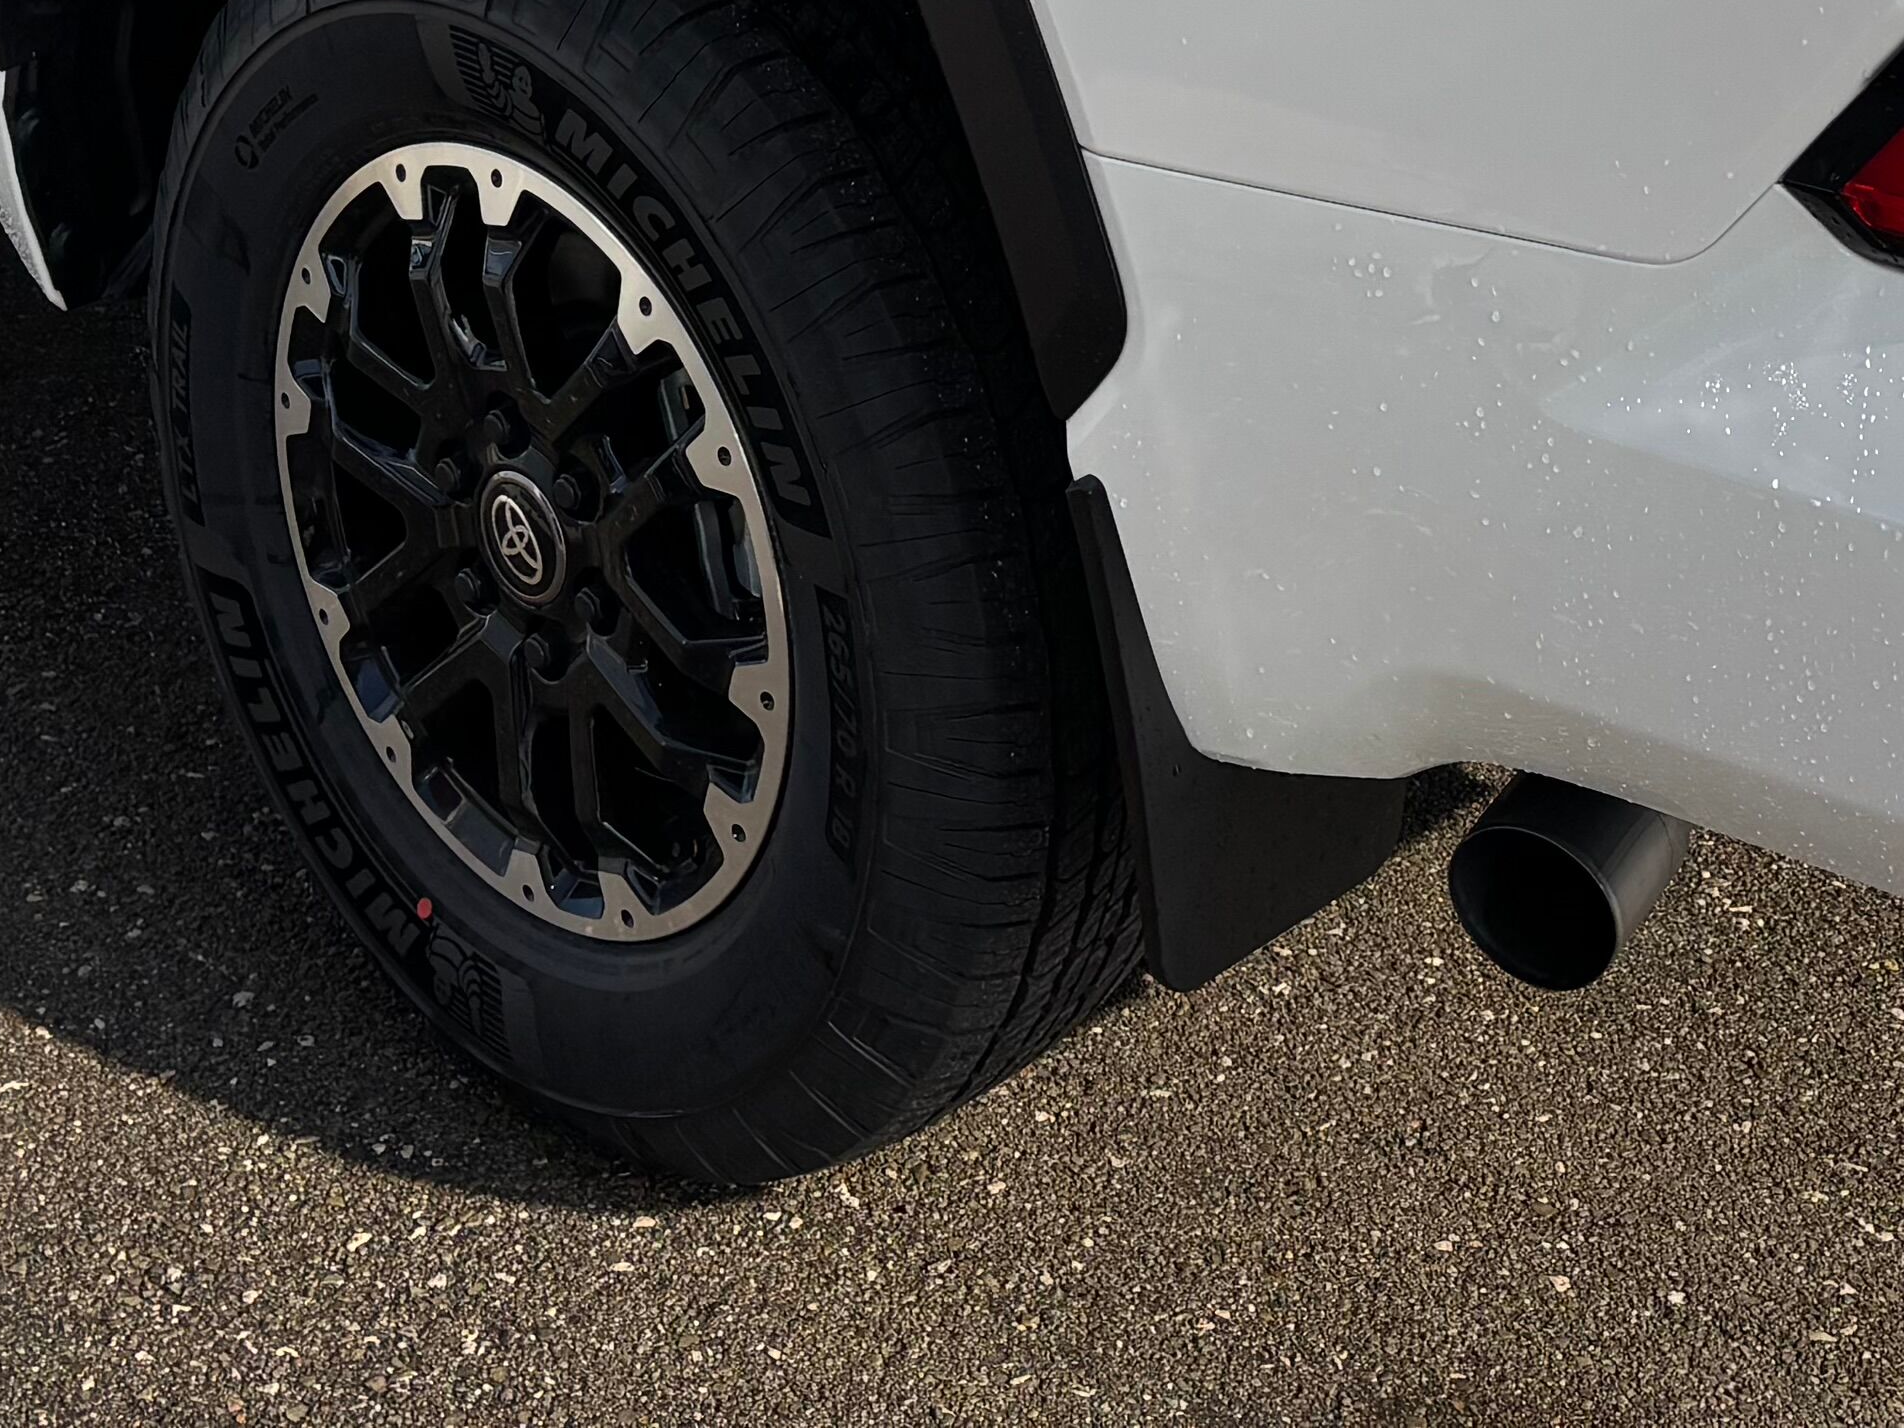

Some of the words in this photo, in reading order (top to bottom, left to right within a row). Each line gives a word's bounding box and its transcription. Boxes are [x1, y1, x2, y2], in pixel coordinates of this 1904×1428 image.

[171, 317, 190, 414] TRAIL
[553, 108, 813, 507] MICHELIN
[208, 591, 422, 960] MICHELIN
